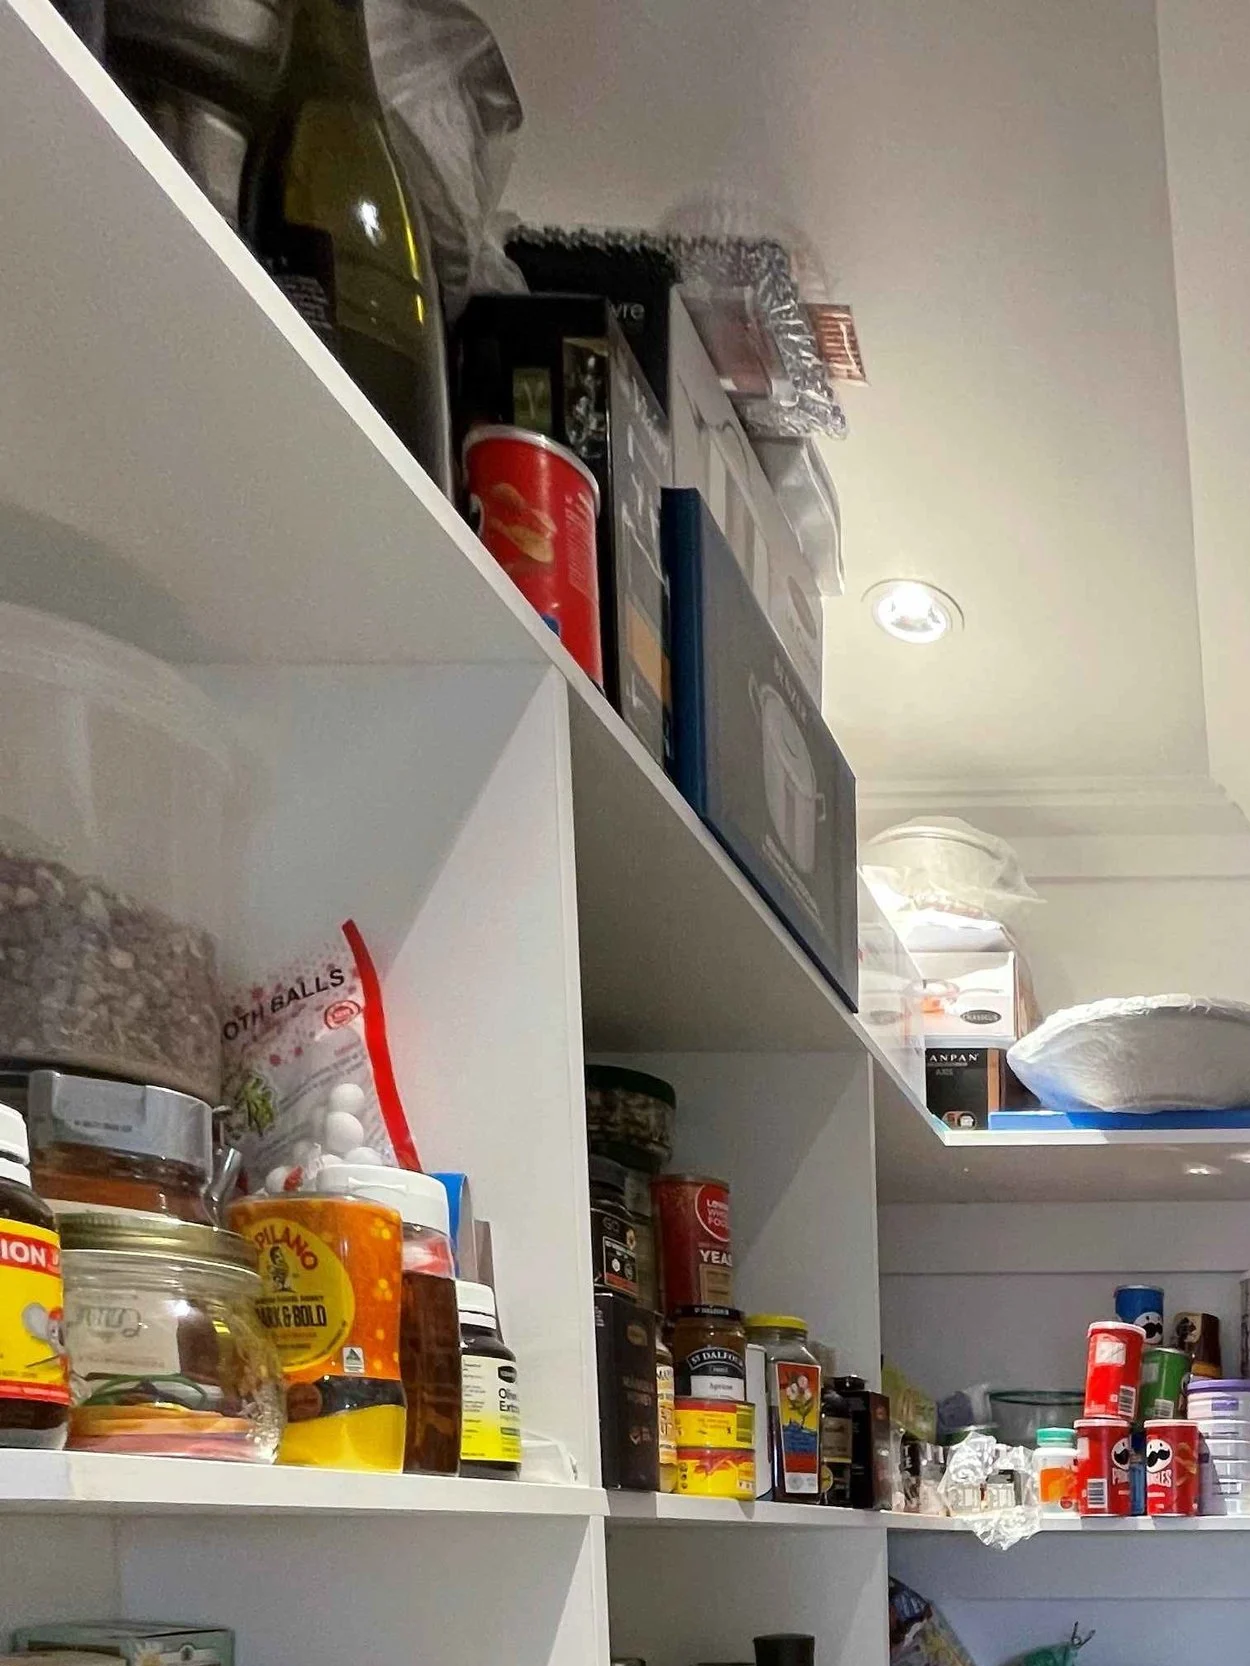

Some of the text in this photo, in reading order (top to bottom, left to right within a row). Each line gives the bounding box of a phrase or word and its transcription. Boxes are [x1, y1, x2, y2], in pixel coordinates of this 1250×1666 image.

[223, 967, 345, 1042] OTH BALLS
[930, 1053, 979, 1062] ANPAN
[254, 1224, 319, 1271] PILANO
[699, 1249, 733, 1267] YEAS
